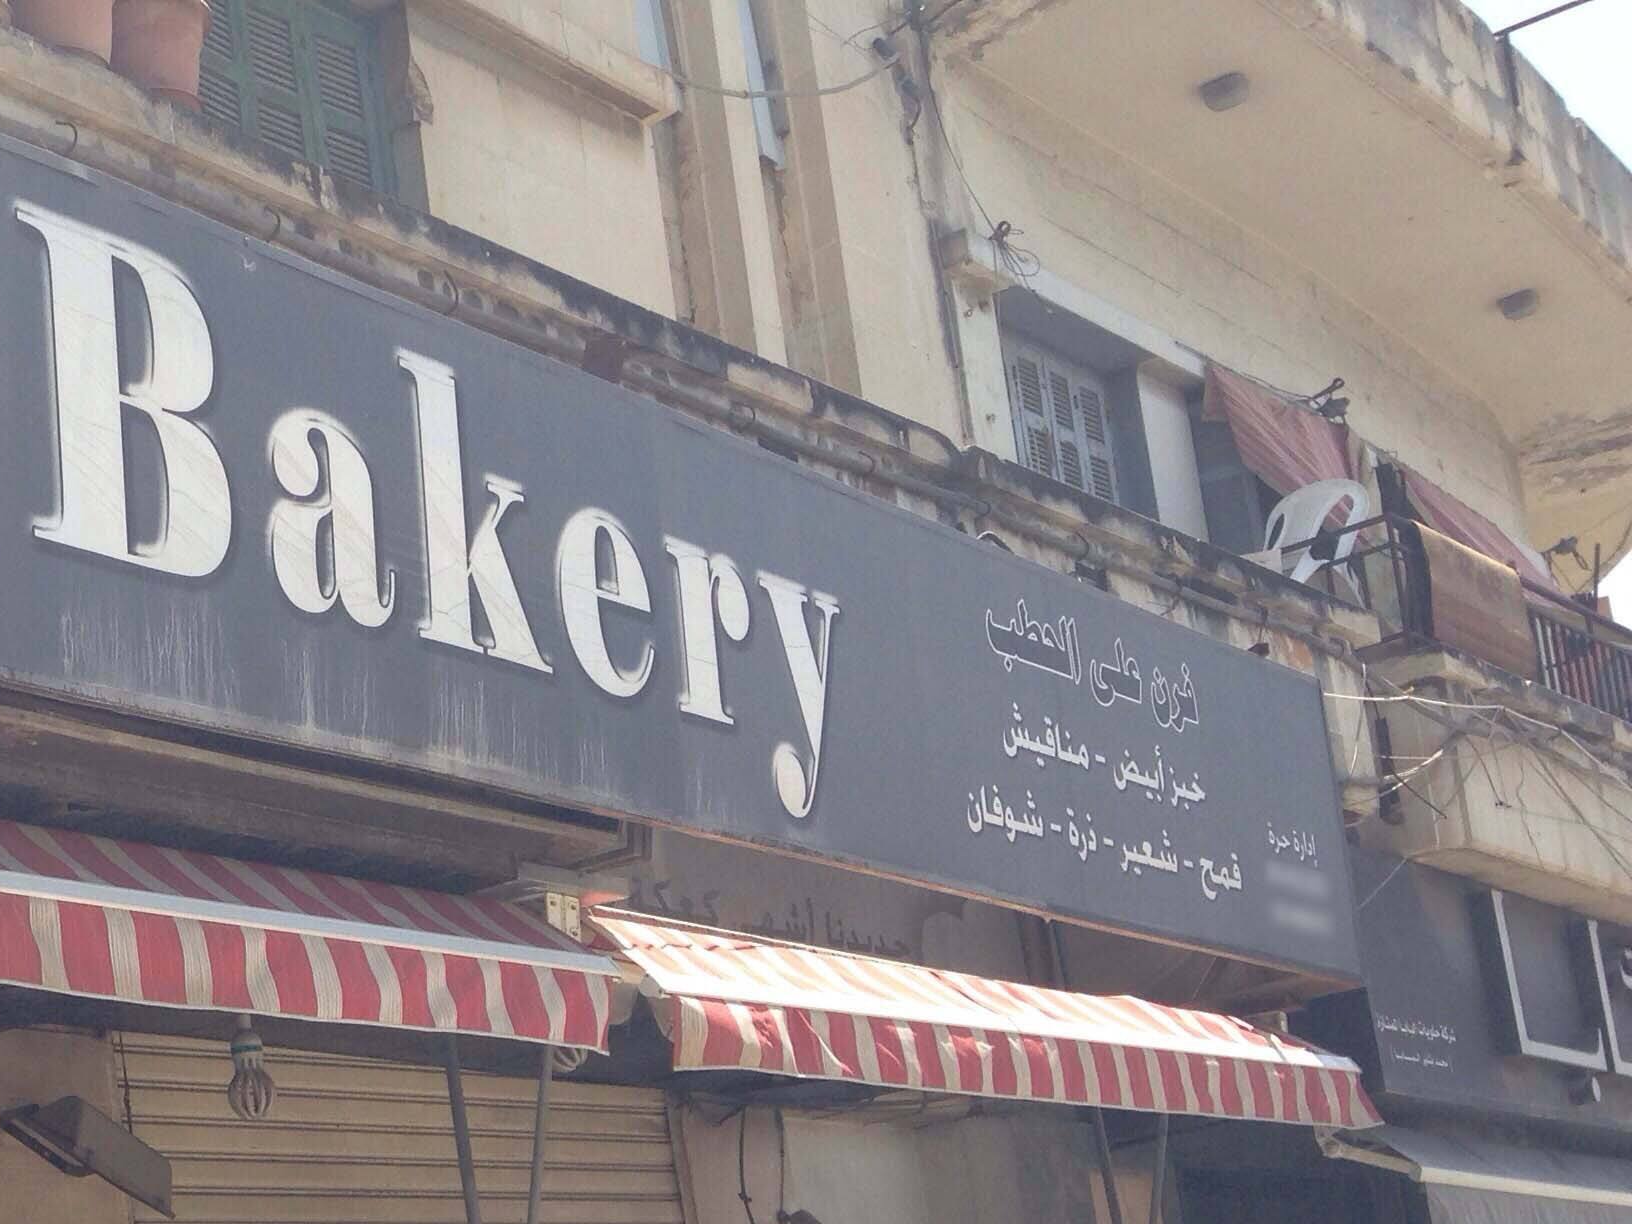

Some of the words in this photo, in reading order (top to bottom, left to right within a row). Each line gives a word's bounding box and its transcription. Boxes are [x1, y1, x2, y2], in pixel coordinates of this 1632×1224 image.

[14, 200, 841, 819] Bakery
[985, 598, 1081, 685] الحطب
[1090, 638, 1142, 707] على
[1151, 663, 1200, 733] فرن
[1003, 702, 1090, 770] مناقيش
[1113, 744, 1165, 802] أبيض
[1168, 766, 1207, 811] خبز
[967, 784, 1044, 843] شوفان
[1067, 807, 1096, 861] ذرة
[1120, 829, 1178, 876] شعير
[1199, 852, 1243, 900] قمح
